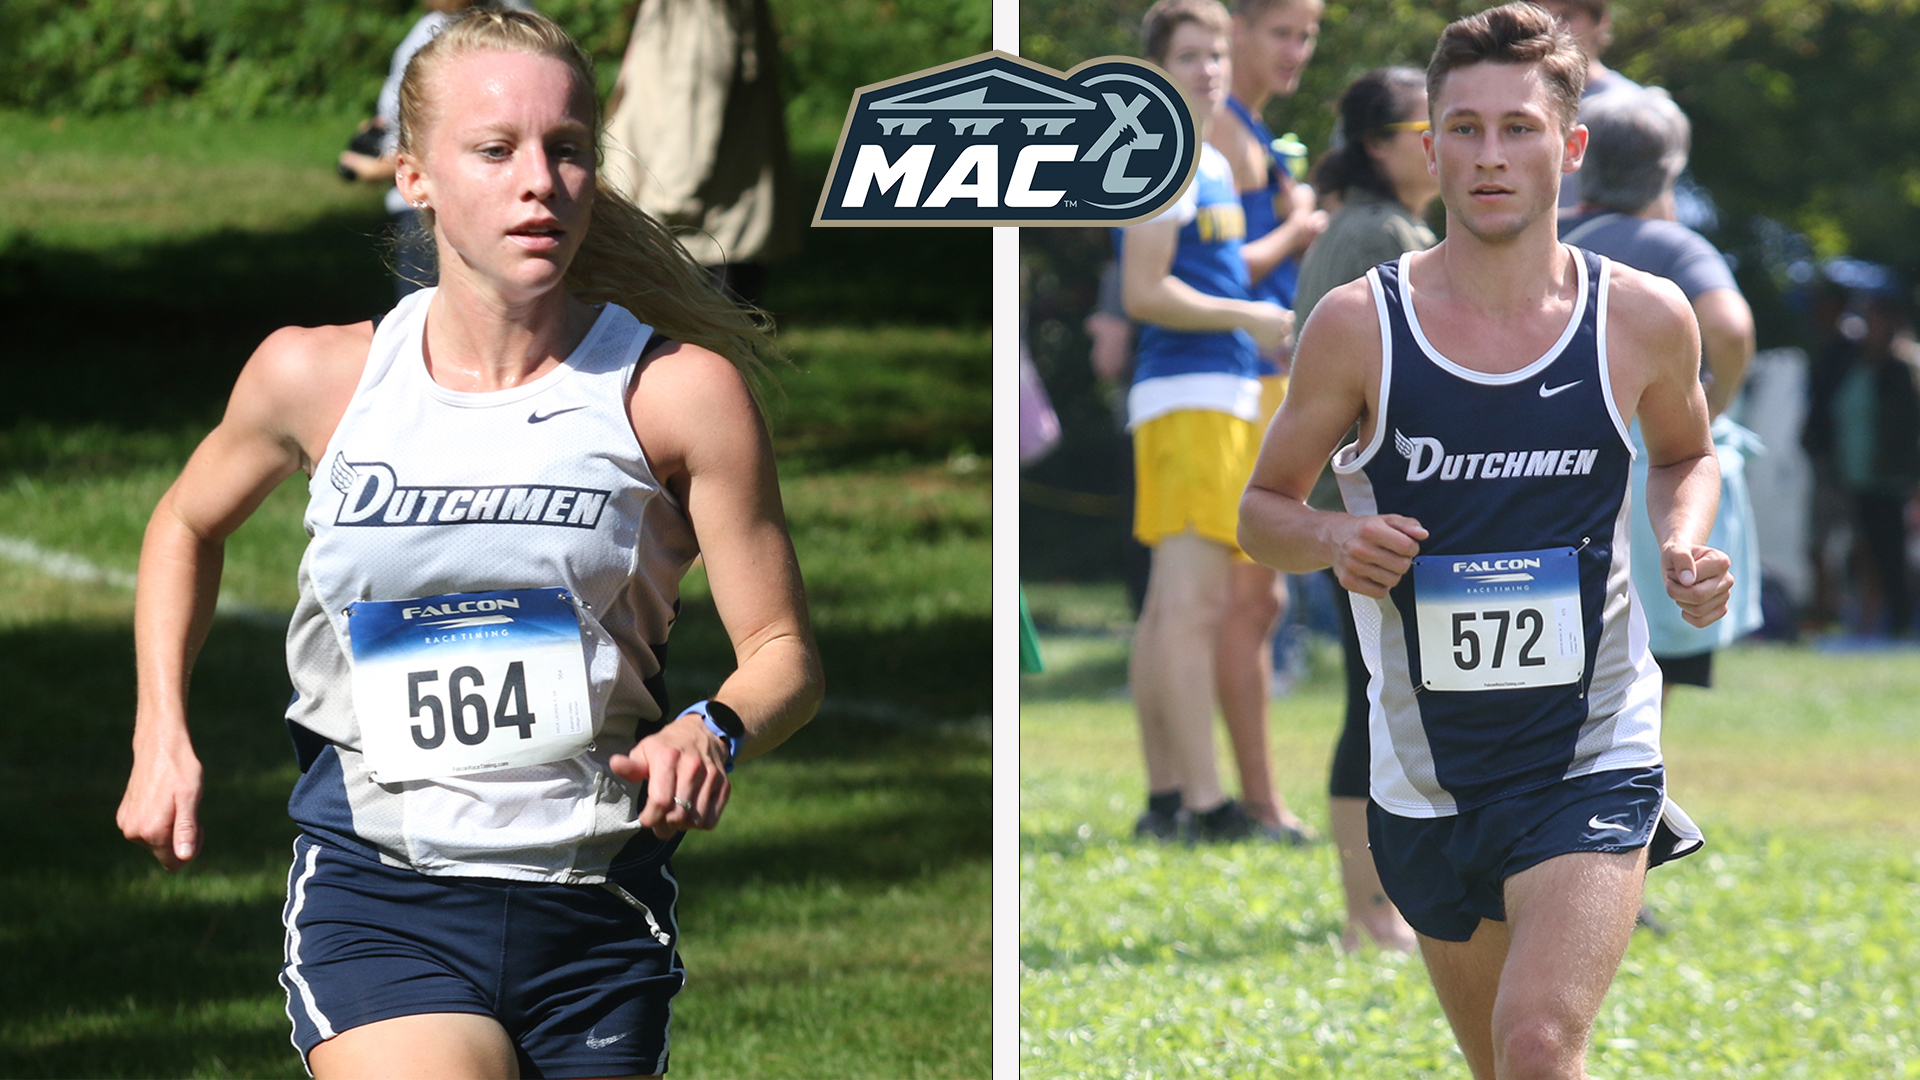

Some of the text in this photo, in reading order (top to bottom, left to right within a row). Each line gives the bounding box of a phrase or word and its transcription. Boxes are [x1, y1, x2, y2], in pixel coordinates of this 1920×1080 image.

[1405, 436, 1599, 482] DUTCHMEN
[336, 462, 609, 526] DUTCHMEN
[1452, 557, 1541, 573] FALCON
[1466, 584, 1530, 594] RACE TIMING
[401, 598, 520, 620] FALCON
[425, 628, 510, 645] RACE TIMING
[1451, 608, 1546, 671] 572
[407, 660, 536, 750] 564
